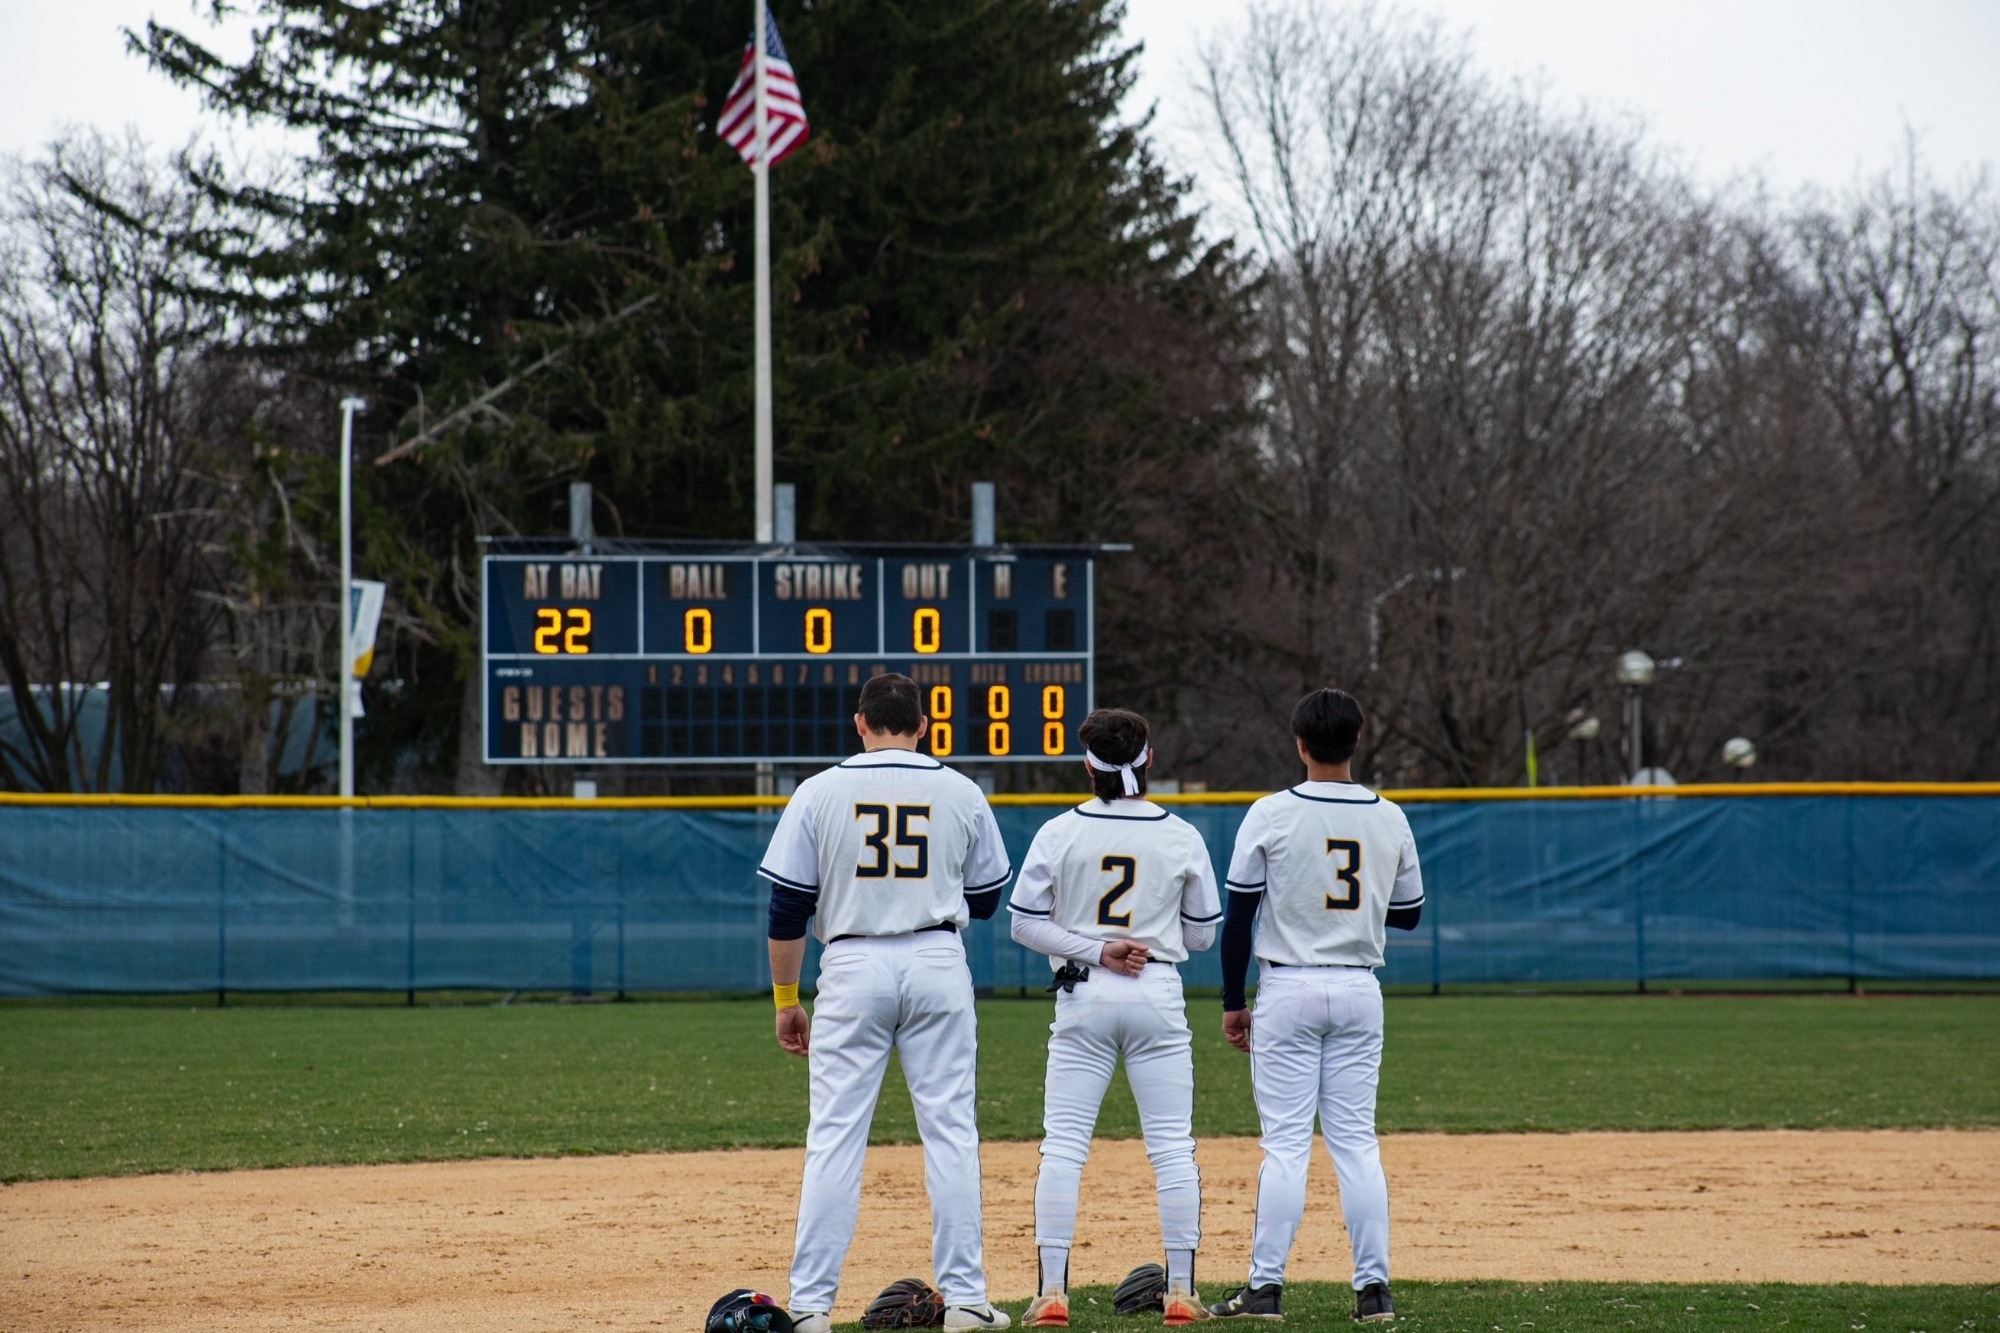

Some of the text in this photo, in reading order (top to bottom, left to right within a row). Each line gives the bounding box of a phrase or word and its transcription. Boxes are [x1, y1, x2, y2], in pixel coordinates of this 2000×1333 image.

[524, 564, 602, 600] AT BAT
[670, 564, 727, 600] BALL
[775, 564, 862, 600] STRIKE
[903, 564, 950, 599] OUT
[1053, 563, 1067, 599] E
[534, 608, 591, 654] 22
[685, 608, 712, 654] 0
[805, 608, 832, 654] 0
[913, 608, 940, 654] 0
[504, 686, 624, 722] GUESTS
[930, 685, 952, 719] 0
[988, 685, 1010, 719] 0
[1042, 685, 1064, 719] 0
[521, 722, 607, 758] HOME
[931, 722, 952, 756] 0
[988, 722, 1010, 756] 0
[1043, 722, 1065, 756] 0
[855, 802, 932, 879] 35
[1096, 854, 1137, 928] 2
[1324, 837, 1362, 912] 3
